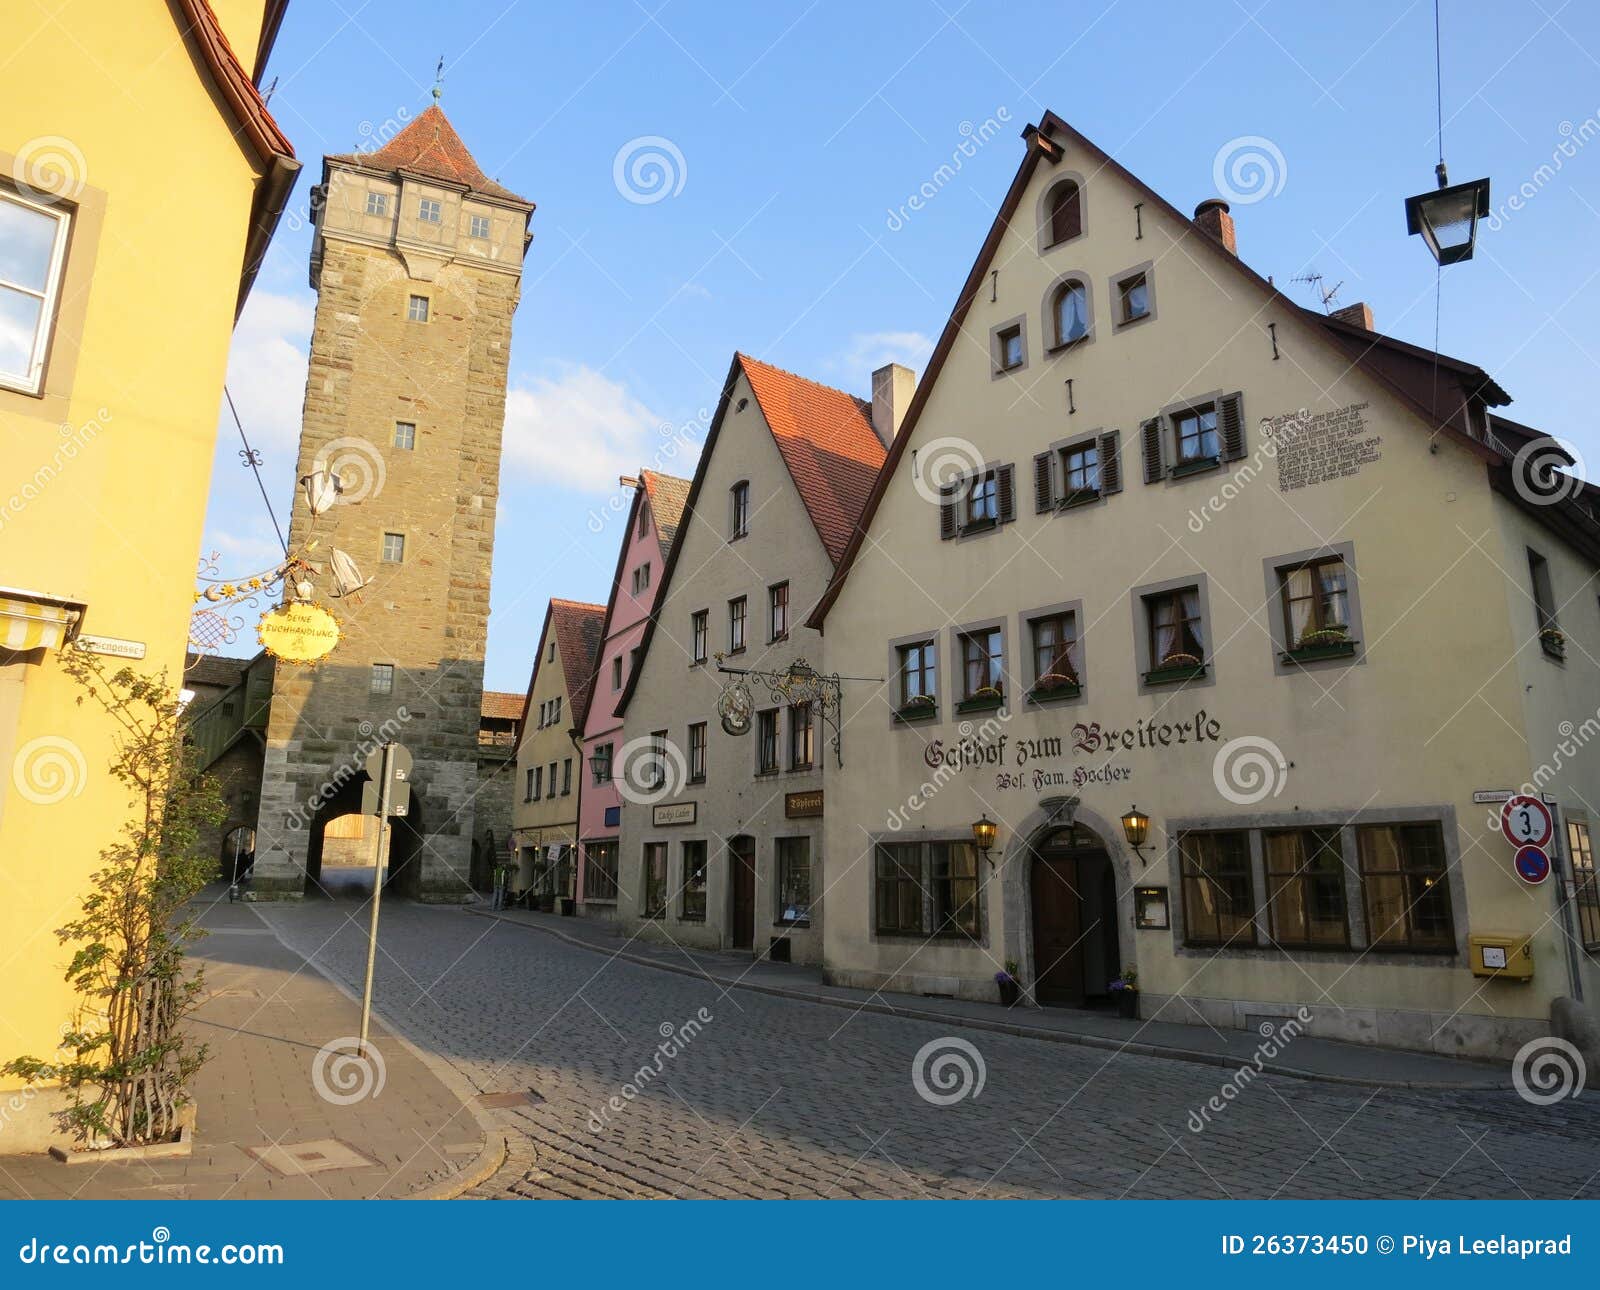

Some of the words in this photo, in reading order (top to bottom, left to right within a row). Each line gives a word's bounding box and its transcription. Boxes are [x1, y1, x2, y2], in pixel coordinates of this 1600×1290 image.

[287, 614, 312, 623] DEINE
[1016, 736, 1062, 767] zum
[1071, 709, 1222, 755] Breiterle
[1519, 811, 1532, 836] 3
